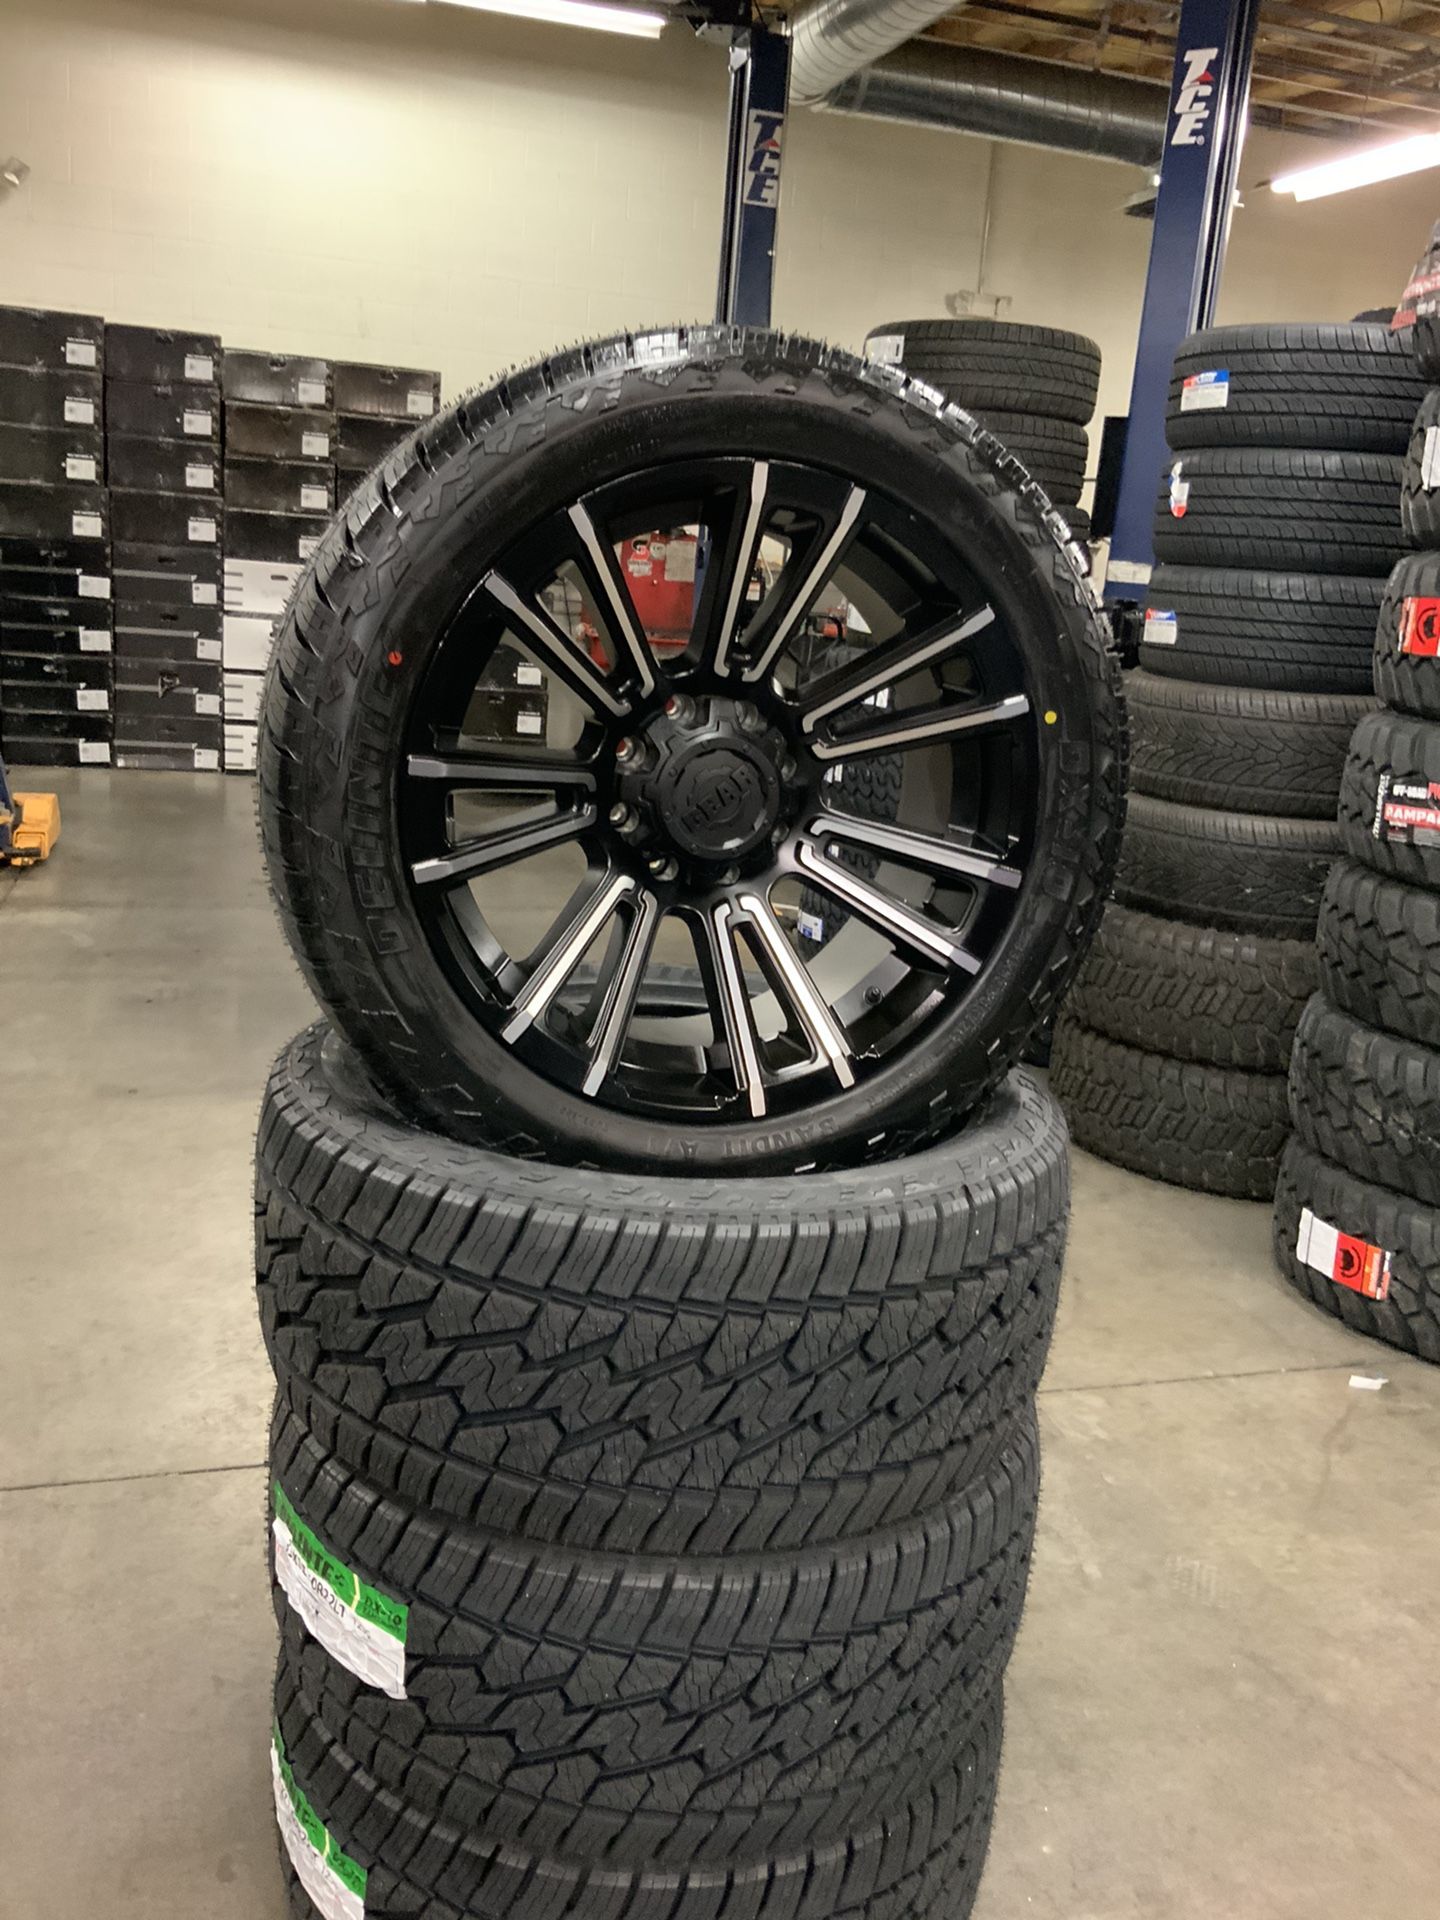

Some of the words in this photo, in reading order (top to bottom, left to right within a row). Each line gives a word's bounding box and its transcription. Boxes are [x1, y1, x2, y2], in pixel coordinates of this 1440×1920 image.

[1171, 48, 1218, 146] TCE
[747, 114, 784, 203] TCE
[1386, 805, 1440, 825] RAMPA
[724, 1116, 839, 1160] BANDIT
